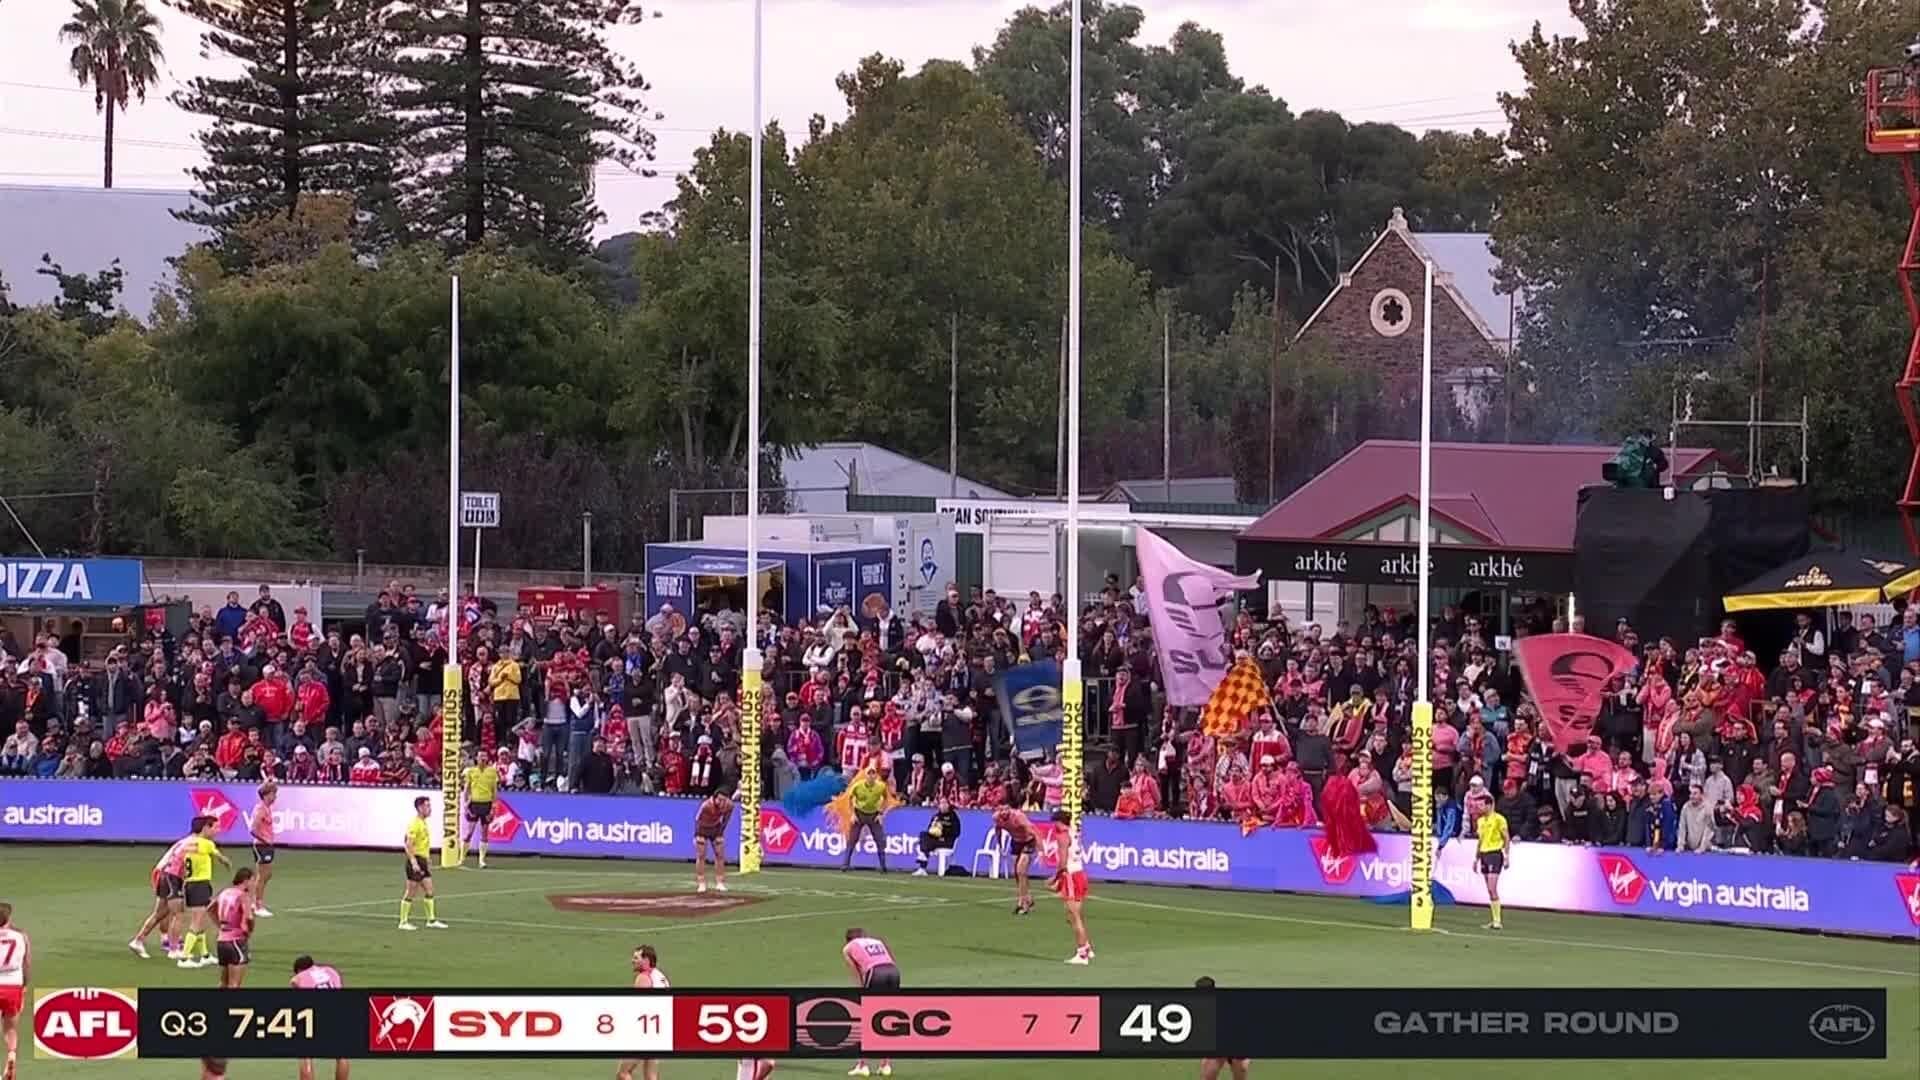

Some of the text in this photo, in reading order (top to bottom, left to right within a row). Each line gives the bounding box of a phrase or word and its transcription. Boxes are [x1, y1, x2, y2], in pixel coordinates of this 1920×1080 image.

[465, 497, 495, 508] TOILET
[1295, 550, 1347, 573] arkhé
[1468, 556, 1524, 578] arkhé
[0, 563, 92, 599] IZZA
[443, 689, 457, 838] SOUTH AUSTRALIA
[4, 804, 103, 826] australia
[242, 808, 304, 833] vgin
[1411, 727, 1424, 895] SOUTH AUSTRALIA
[524, 816, 582, 844] virgin
[586, 821, 673, 844] australia
[1081, 842, 1138, 870] virgin
[1142, 847, 1229, 871] australia
[1650, 877, 1809, 912] virgin australia
